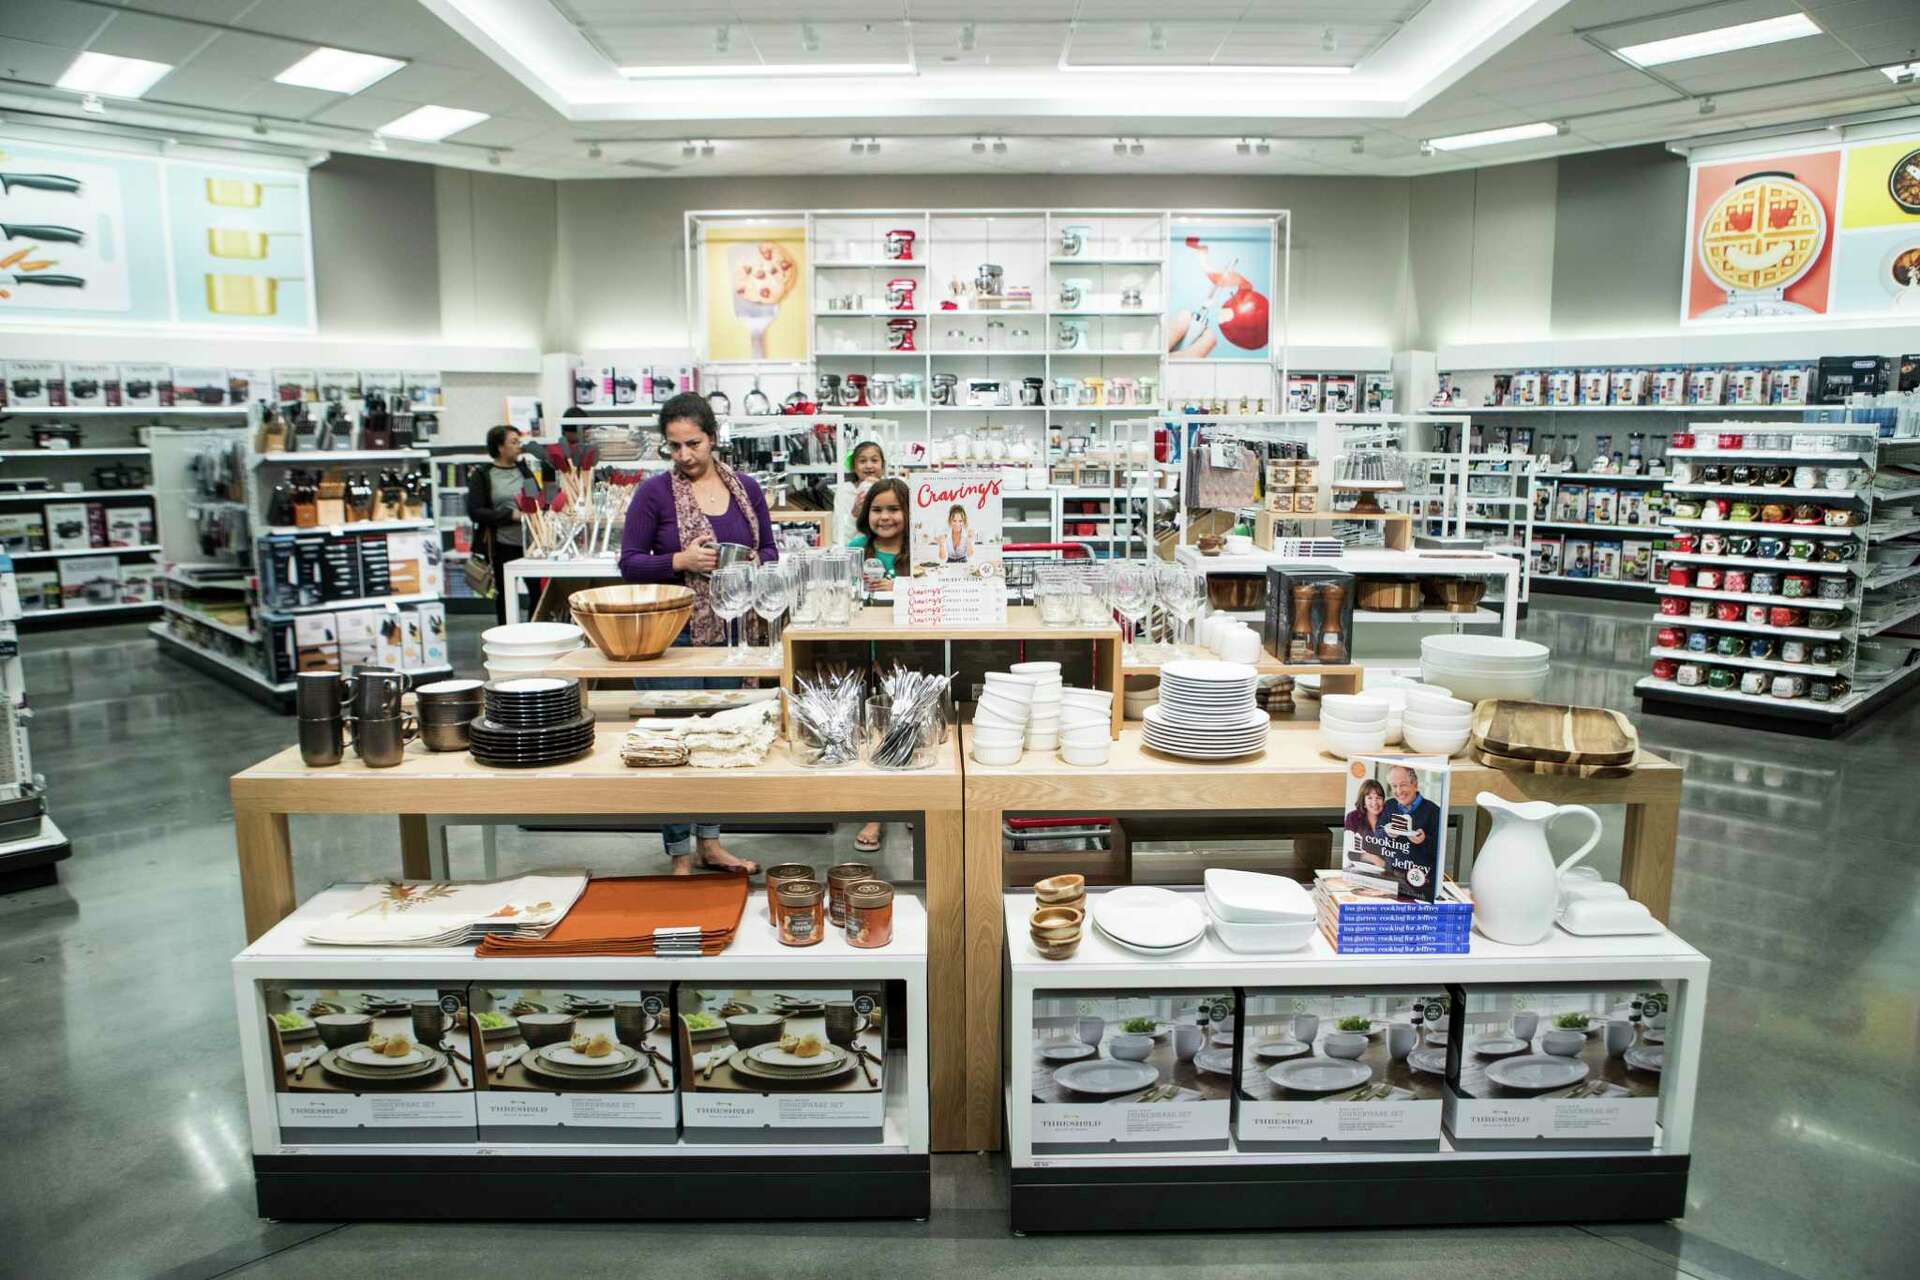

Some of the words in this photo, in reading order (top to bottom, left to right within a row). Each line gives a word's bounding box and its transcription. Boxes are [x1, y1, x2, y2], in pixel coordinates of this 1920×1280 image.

[917, 479, 1002, 510] Cravings
[1365, 835, 1410, 854] cooking
[1381, 846, 1396, 858] for
